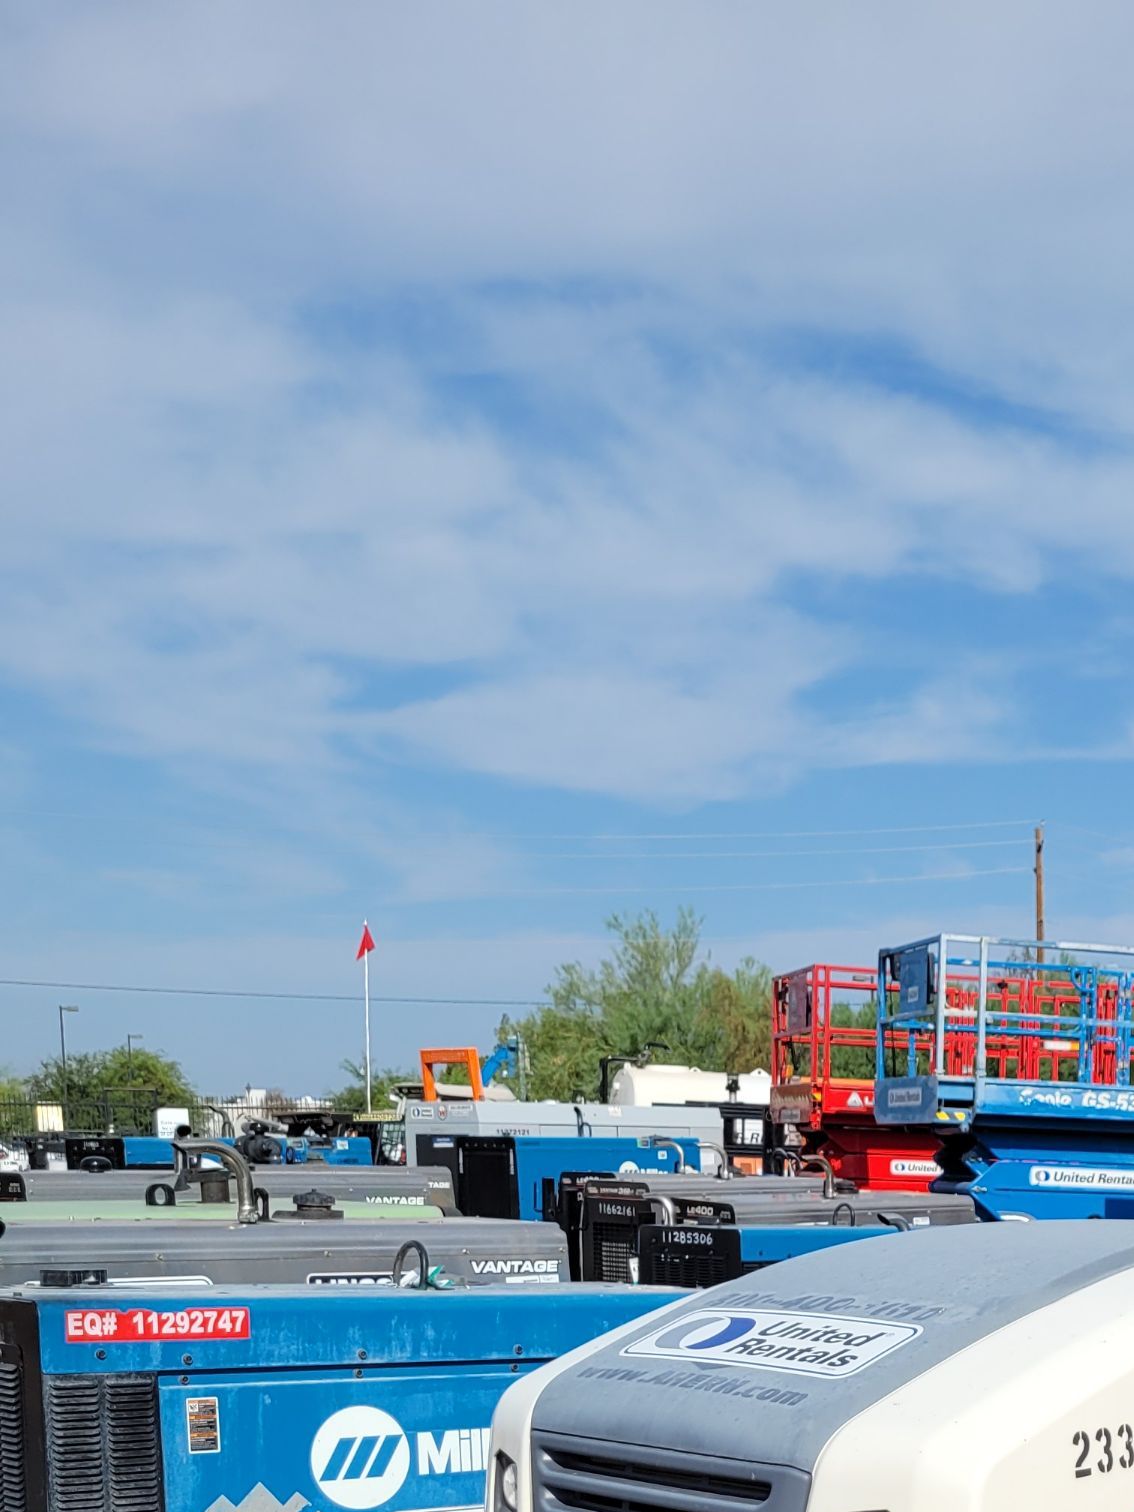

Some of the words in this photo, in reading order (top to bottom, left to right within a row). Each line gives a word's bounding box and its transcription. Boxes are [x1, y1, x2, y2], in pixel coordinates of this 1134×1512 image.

[1053, 1170, 1096, 1184] United
[366, 1196, 425, 1206] VANTAGE
[662, 1231, 713, 1246] 11285306
[471, 1260, 558, 1275] VANTAGE
[67, 1312, 118, 1337] EQ#
[132, 1310, 246, 1335] 11292747
[757, 1320, 886, 1348] United
[723, 1338, 859, 1369] Rentals
